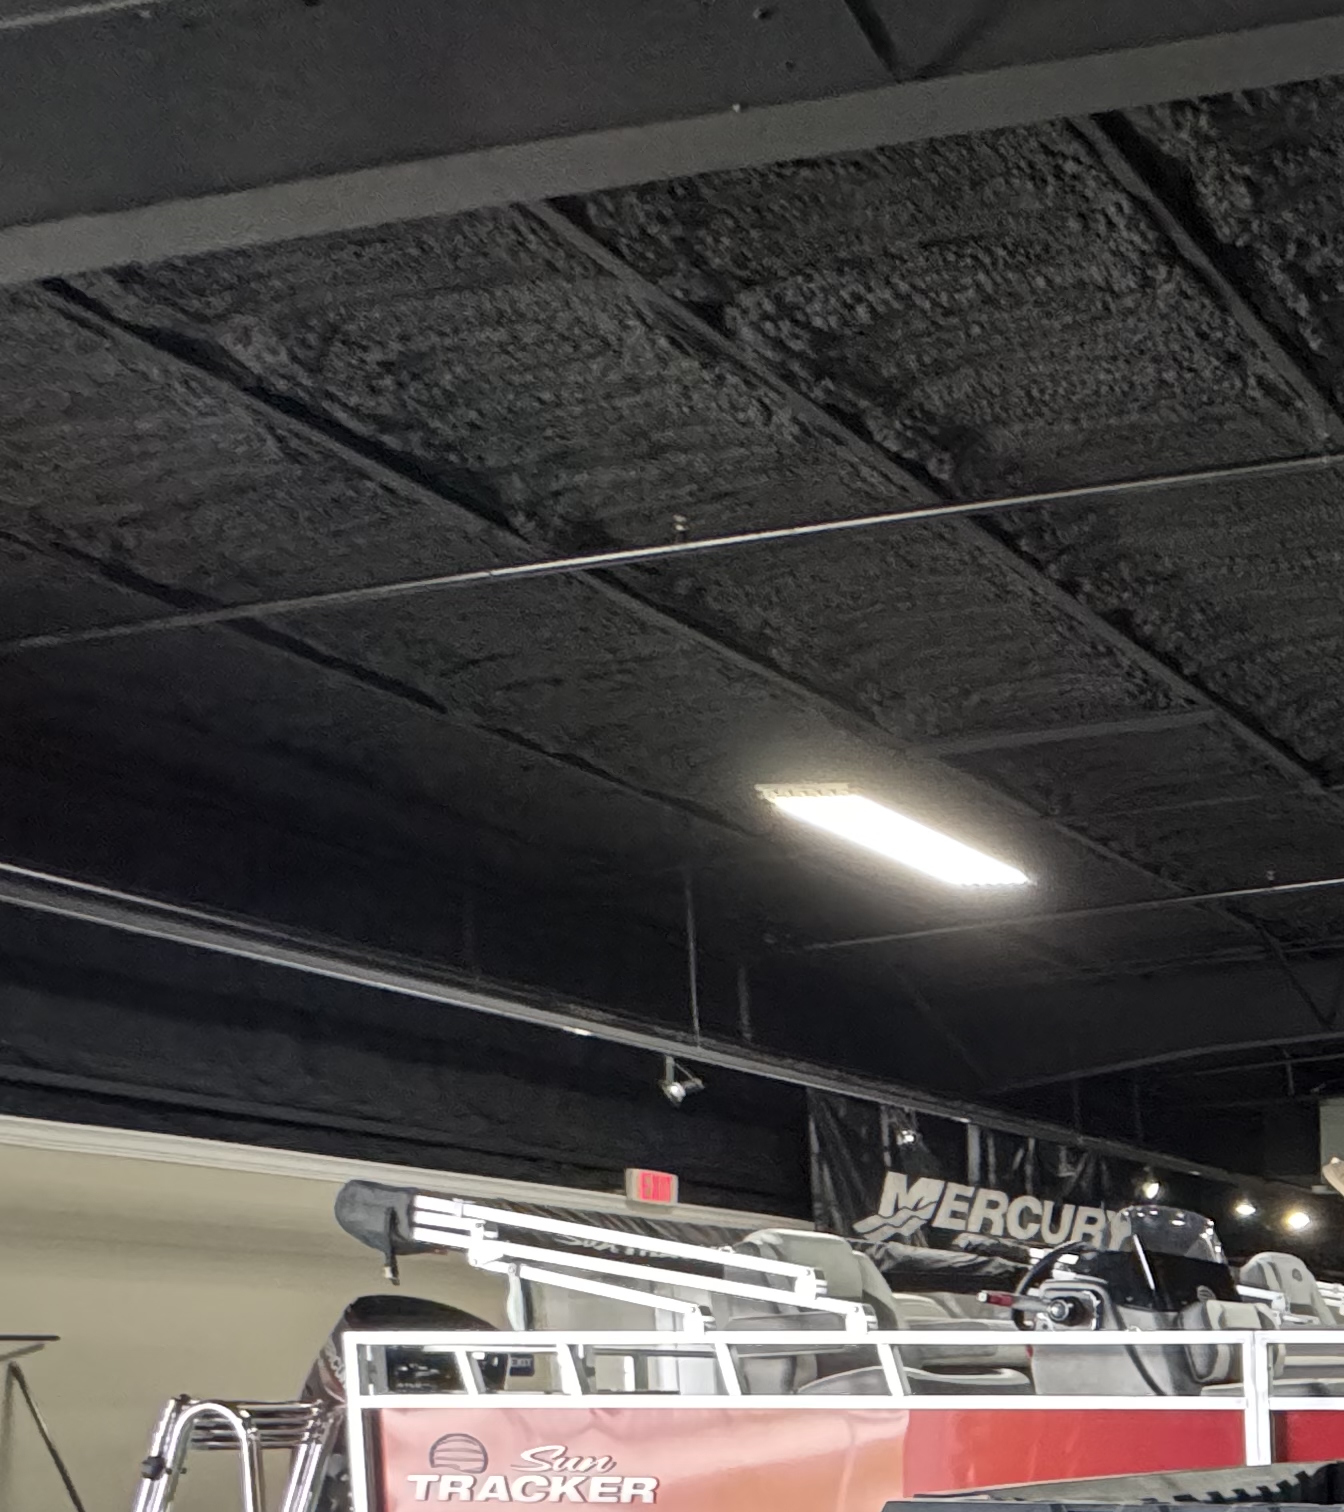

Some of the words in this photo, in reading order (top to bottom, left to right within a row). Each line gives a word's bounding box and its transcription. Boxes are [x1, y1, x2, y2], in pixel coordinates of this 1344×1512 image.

[853, 1171, 1132, 1251] MERCURY
[511, 1445, 618, 1473] Sun
[406, 1474, 661, 1504] TRACKER
